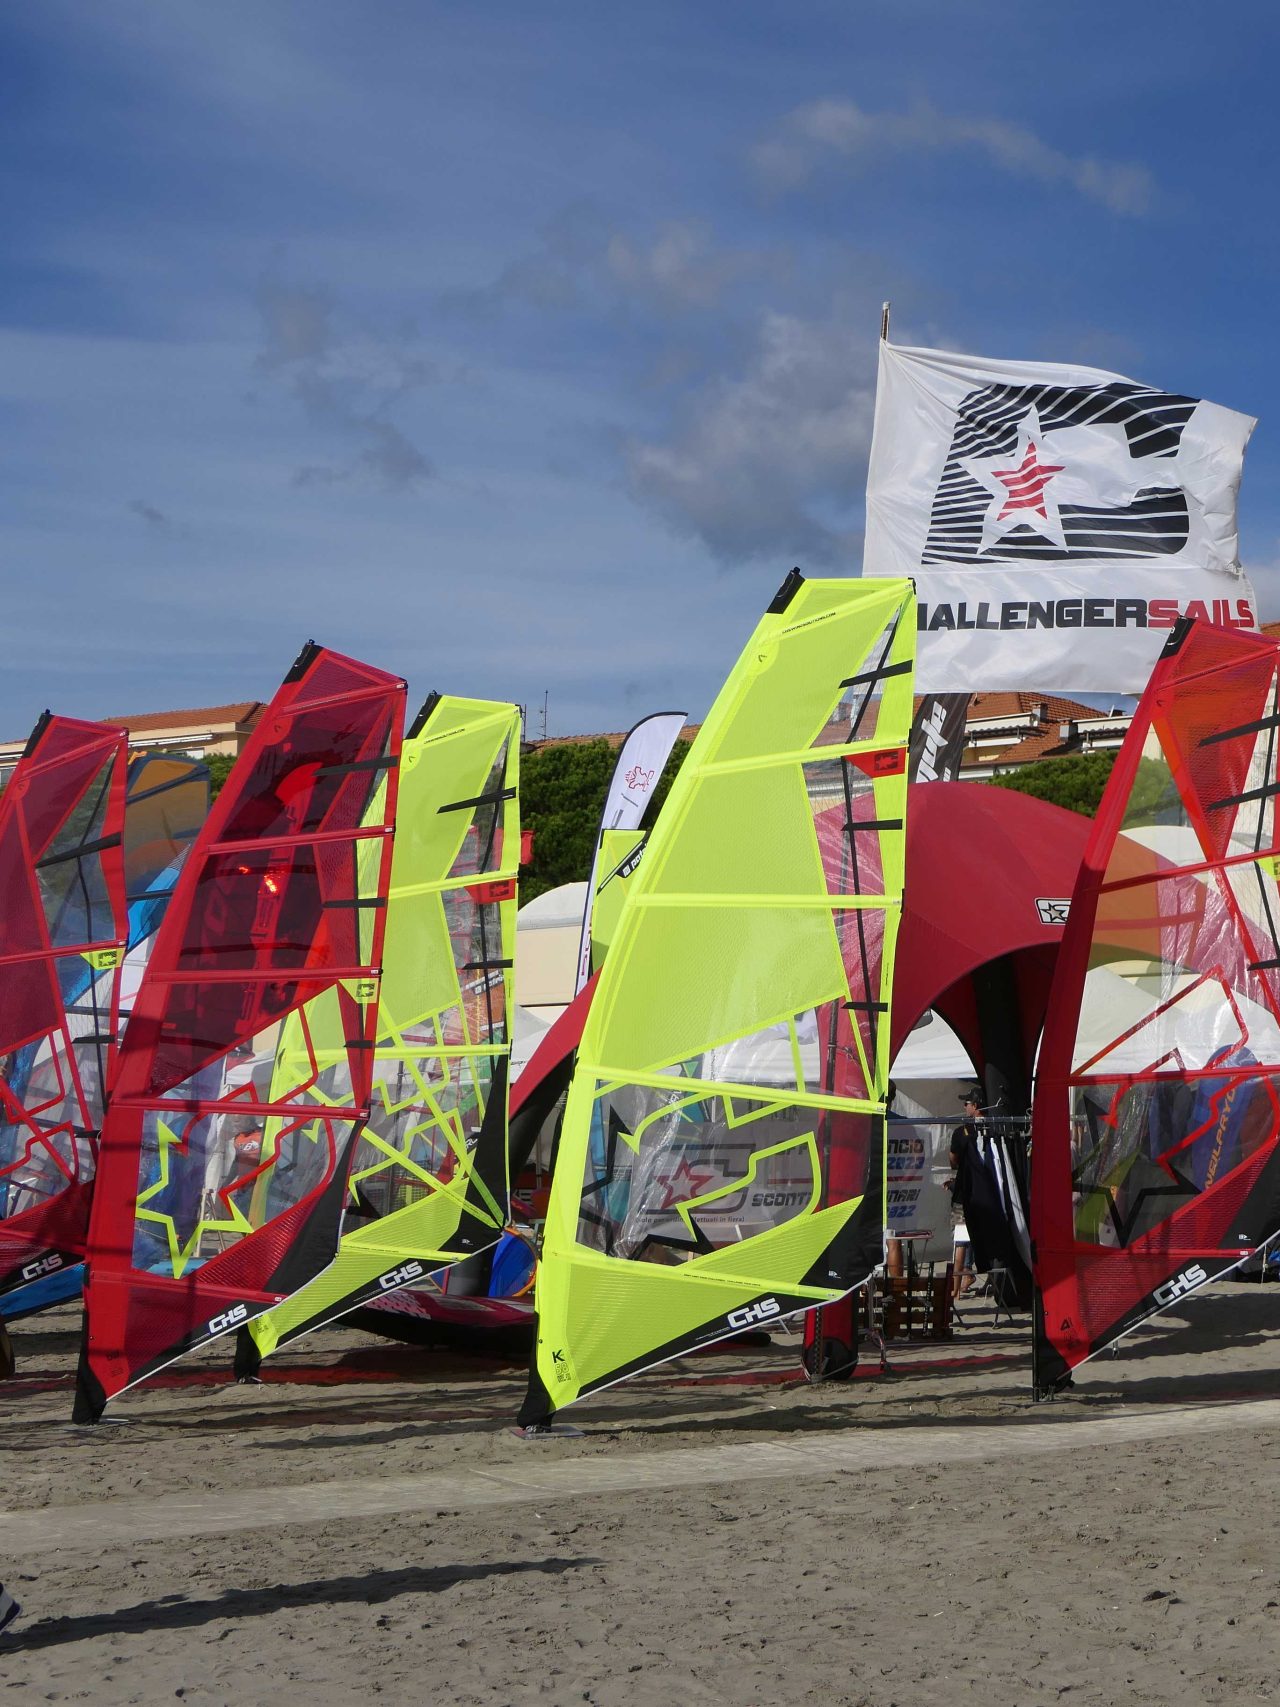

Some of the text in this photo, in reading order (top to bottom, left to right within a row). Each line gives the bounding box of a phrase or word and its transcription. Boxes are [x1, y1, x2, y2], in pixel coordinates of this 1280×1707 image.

[917, 599, 1255, 632] ALLENGERSAILS
[22, 1253, 63, 1281] CHS
[380, 1261, 422, 1291] CHS
[1152, 1264, 1207, 1306] CHS
[208, 1303, 248, 1335] CHS
[727, 1297, 780, 1329] CHS
